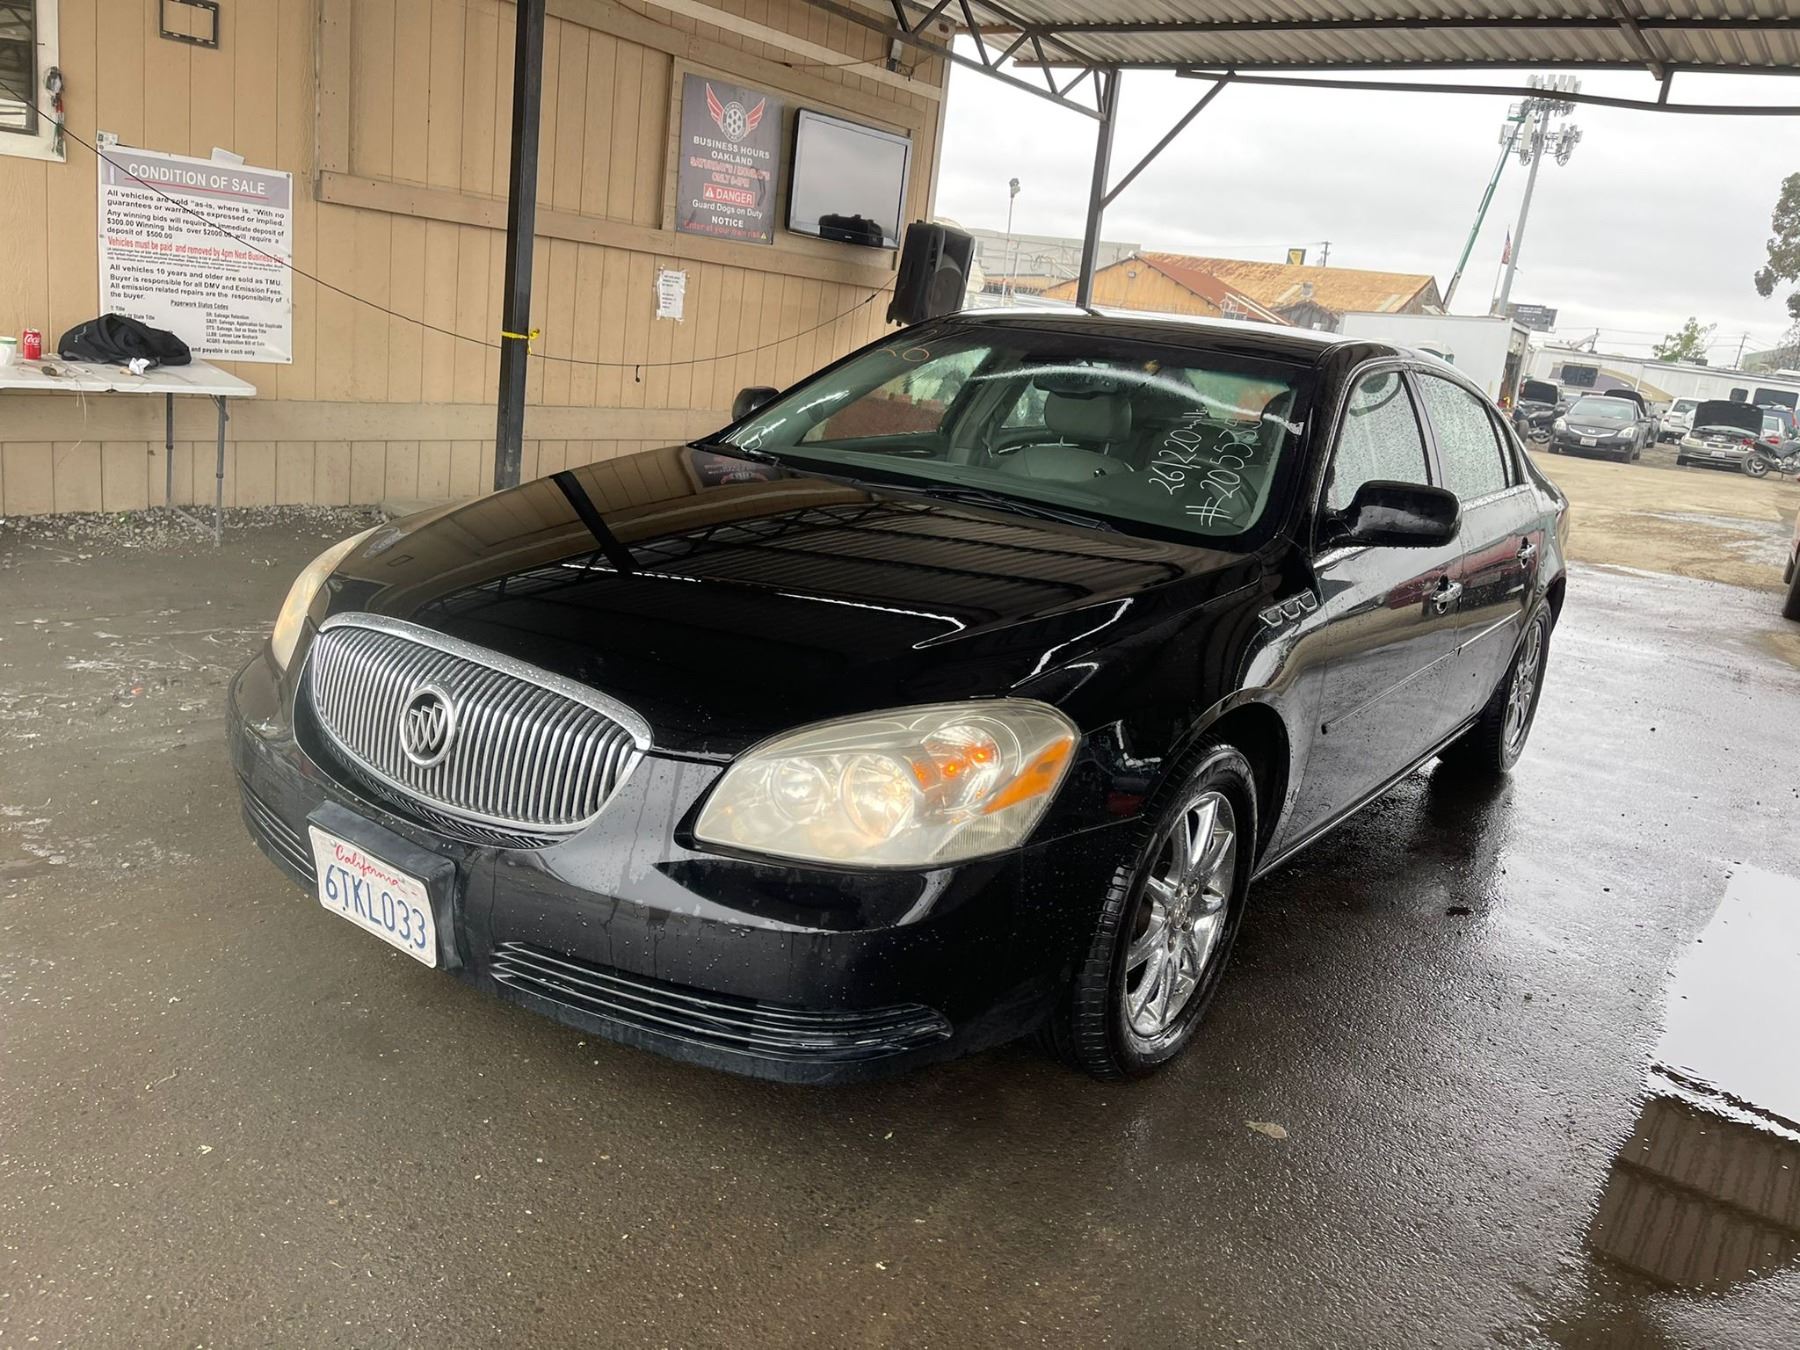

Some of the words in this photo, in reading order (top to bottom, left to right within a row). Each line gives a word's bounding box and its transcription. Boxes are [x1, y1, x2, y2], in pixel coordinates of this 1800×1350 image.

[693, 135, 738, 153] BUSINESS
[741, 146, 770, 159] HOURS
[711, 150, 753, 166] OAKLAND
[128, 163, 207, 186] CONDITION
[210, 175, 228, 189] OF
[231, 179, 265, 195] SALE
[120, 191, 154, 201] vehicles
[217, 204, 239, 212] where
[716, 188, 752, 204] DANGER
[107, 199, 152, 210] guarantees
[164, 206, 205, 216] warranties
[206, 211, 245, 221] expressed
[692, 199, 715, 210] Guard
[717, 203, 735, 214] Dogs
[747, 208, 762, 219] Duty
[107, 209, 121, 217] Any
[123, 211, 151, 221] winning
[152, 214, 167, 222] bids
[182, 218, 207, 227] require
[217, 221, 251, 232] immediate
[252, 228, 276, 236] deposit
[107, 217, 134, 227] $300.00
[135, 221, 165, 231] Winning
[249, 235, 272, 243] require
[711, 215, 744, 228] NOTICE
[107, 227, 134, 236] deposit
[146, 230, 173, 239] $500.00
[107, 236, 133, 248] Vehicles
[134, 240, 150, 249] must
[151, 241, 158, 250] be
[160, 243, 172, 253] paid
[175, 244, 186, 253] and
[187, 245, 212, 256] removed
[213, 248, 220, 258] by
[221, 249, 233, 259] 4pm
[235, 249, 247, 259] Next
[248, 251, 272, 263] Business
[122, 265, 154, 274] vehicles
[110, 274, 131, 283] Buyer
[141, 277, 181, 286] responsible
[235, 285, 265, 294] Emission
[121, 284, 154, 292] emission
[231, 293, 274, 303] responsibility
[170, 300, 197, 308] Paperwork
[198, 301, 213, 309] Status
[214, 302, 229, 311] Codes
[335, 844, 402, 889] California
[325, 864, 426, 949] 6TKL033
